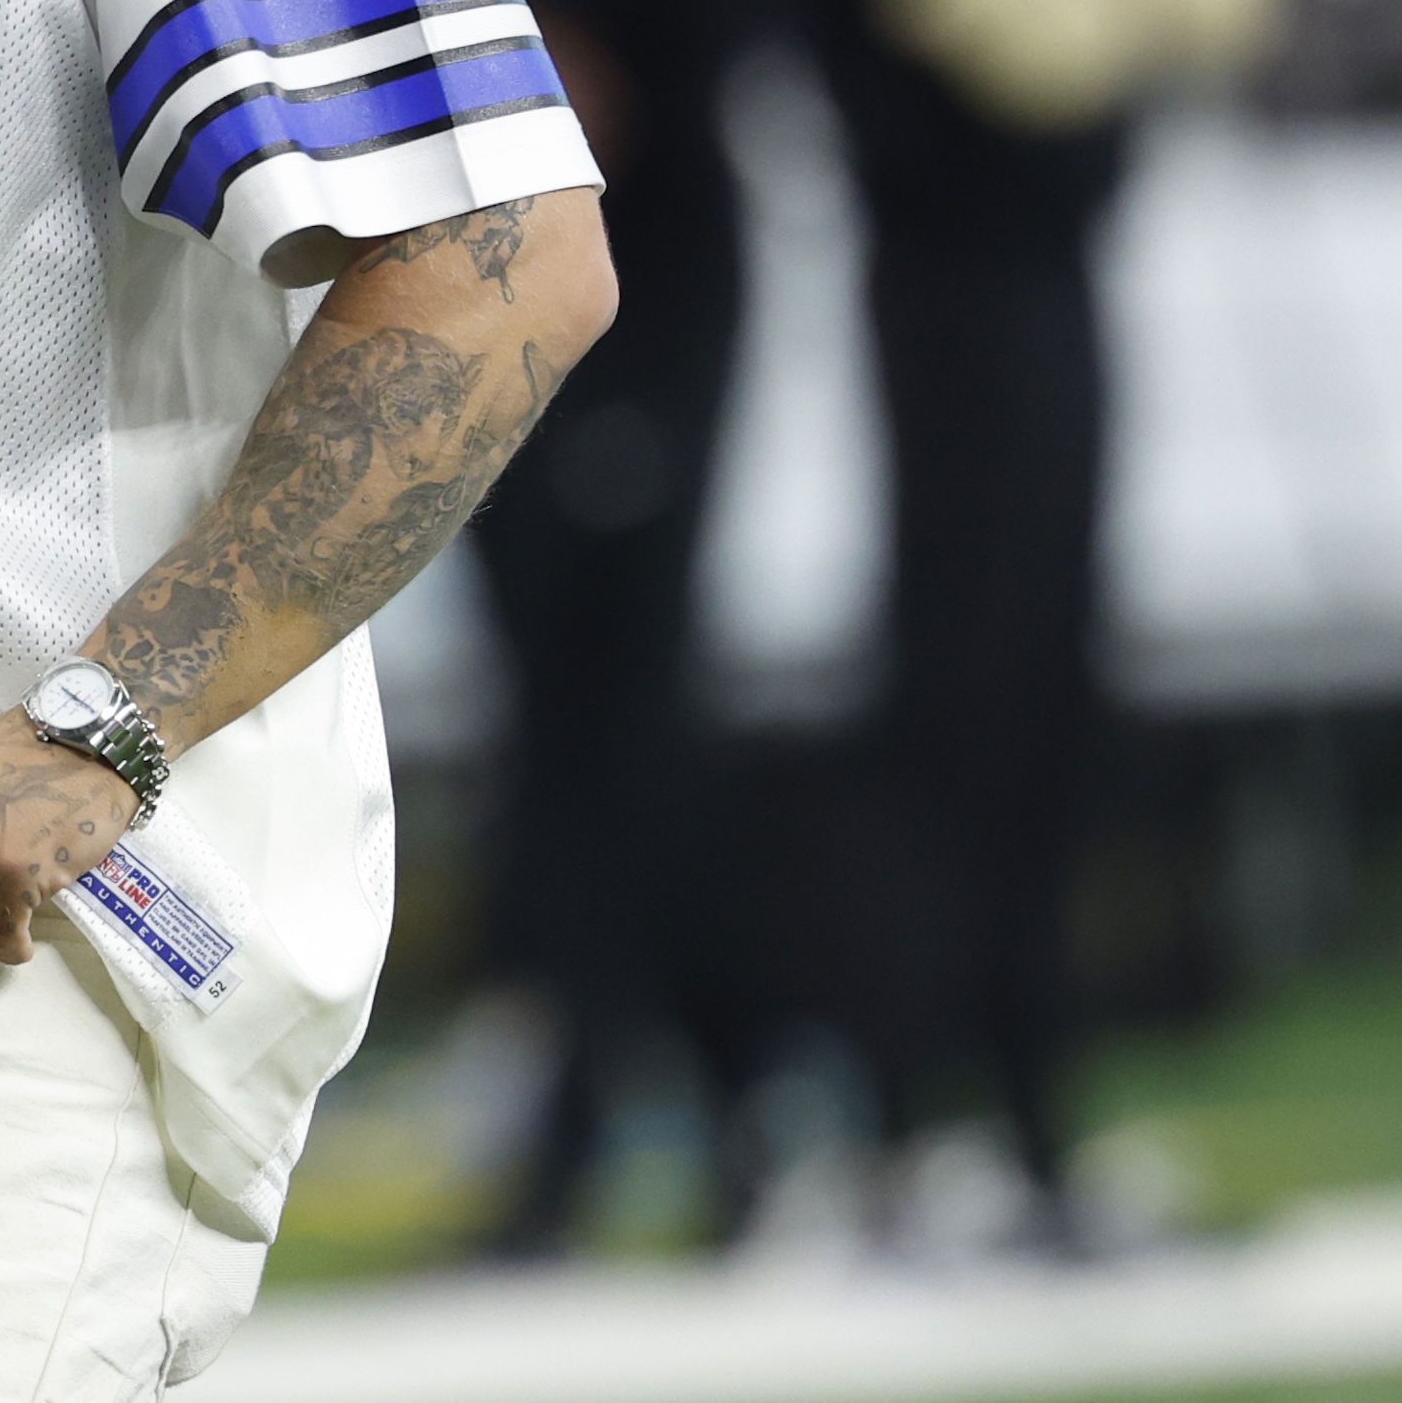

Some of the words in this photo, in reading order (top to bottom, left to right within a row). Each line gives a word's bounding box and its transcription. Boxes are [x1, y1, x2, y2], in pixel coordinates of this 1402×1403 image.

[97, 857, 123, 883] NFL
[127, 868, 160, 897] PRO
[118, 879, 151, 909] LINE
[79, 873, 202, 986] AUTHENTIC
[208, 980, 227, 999] 52
